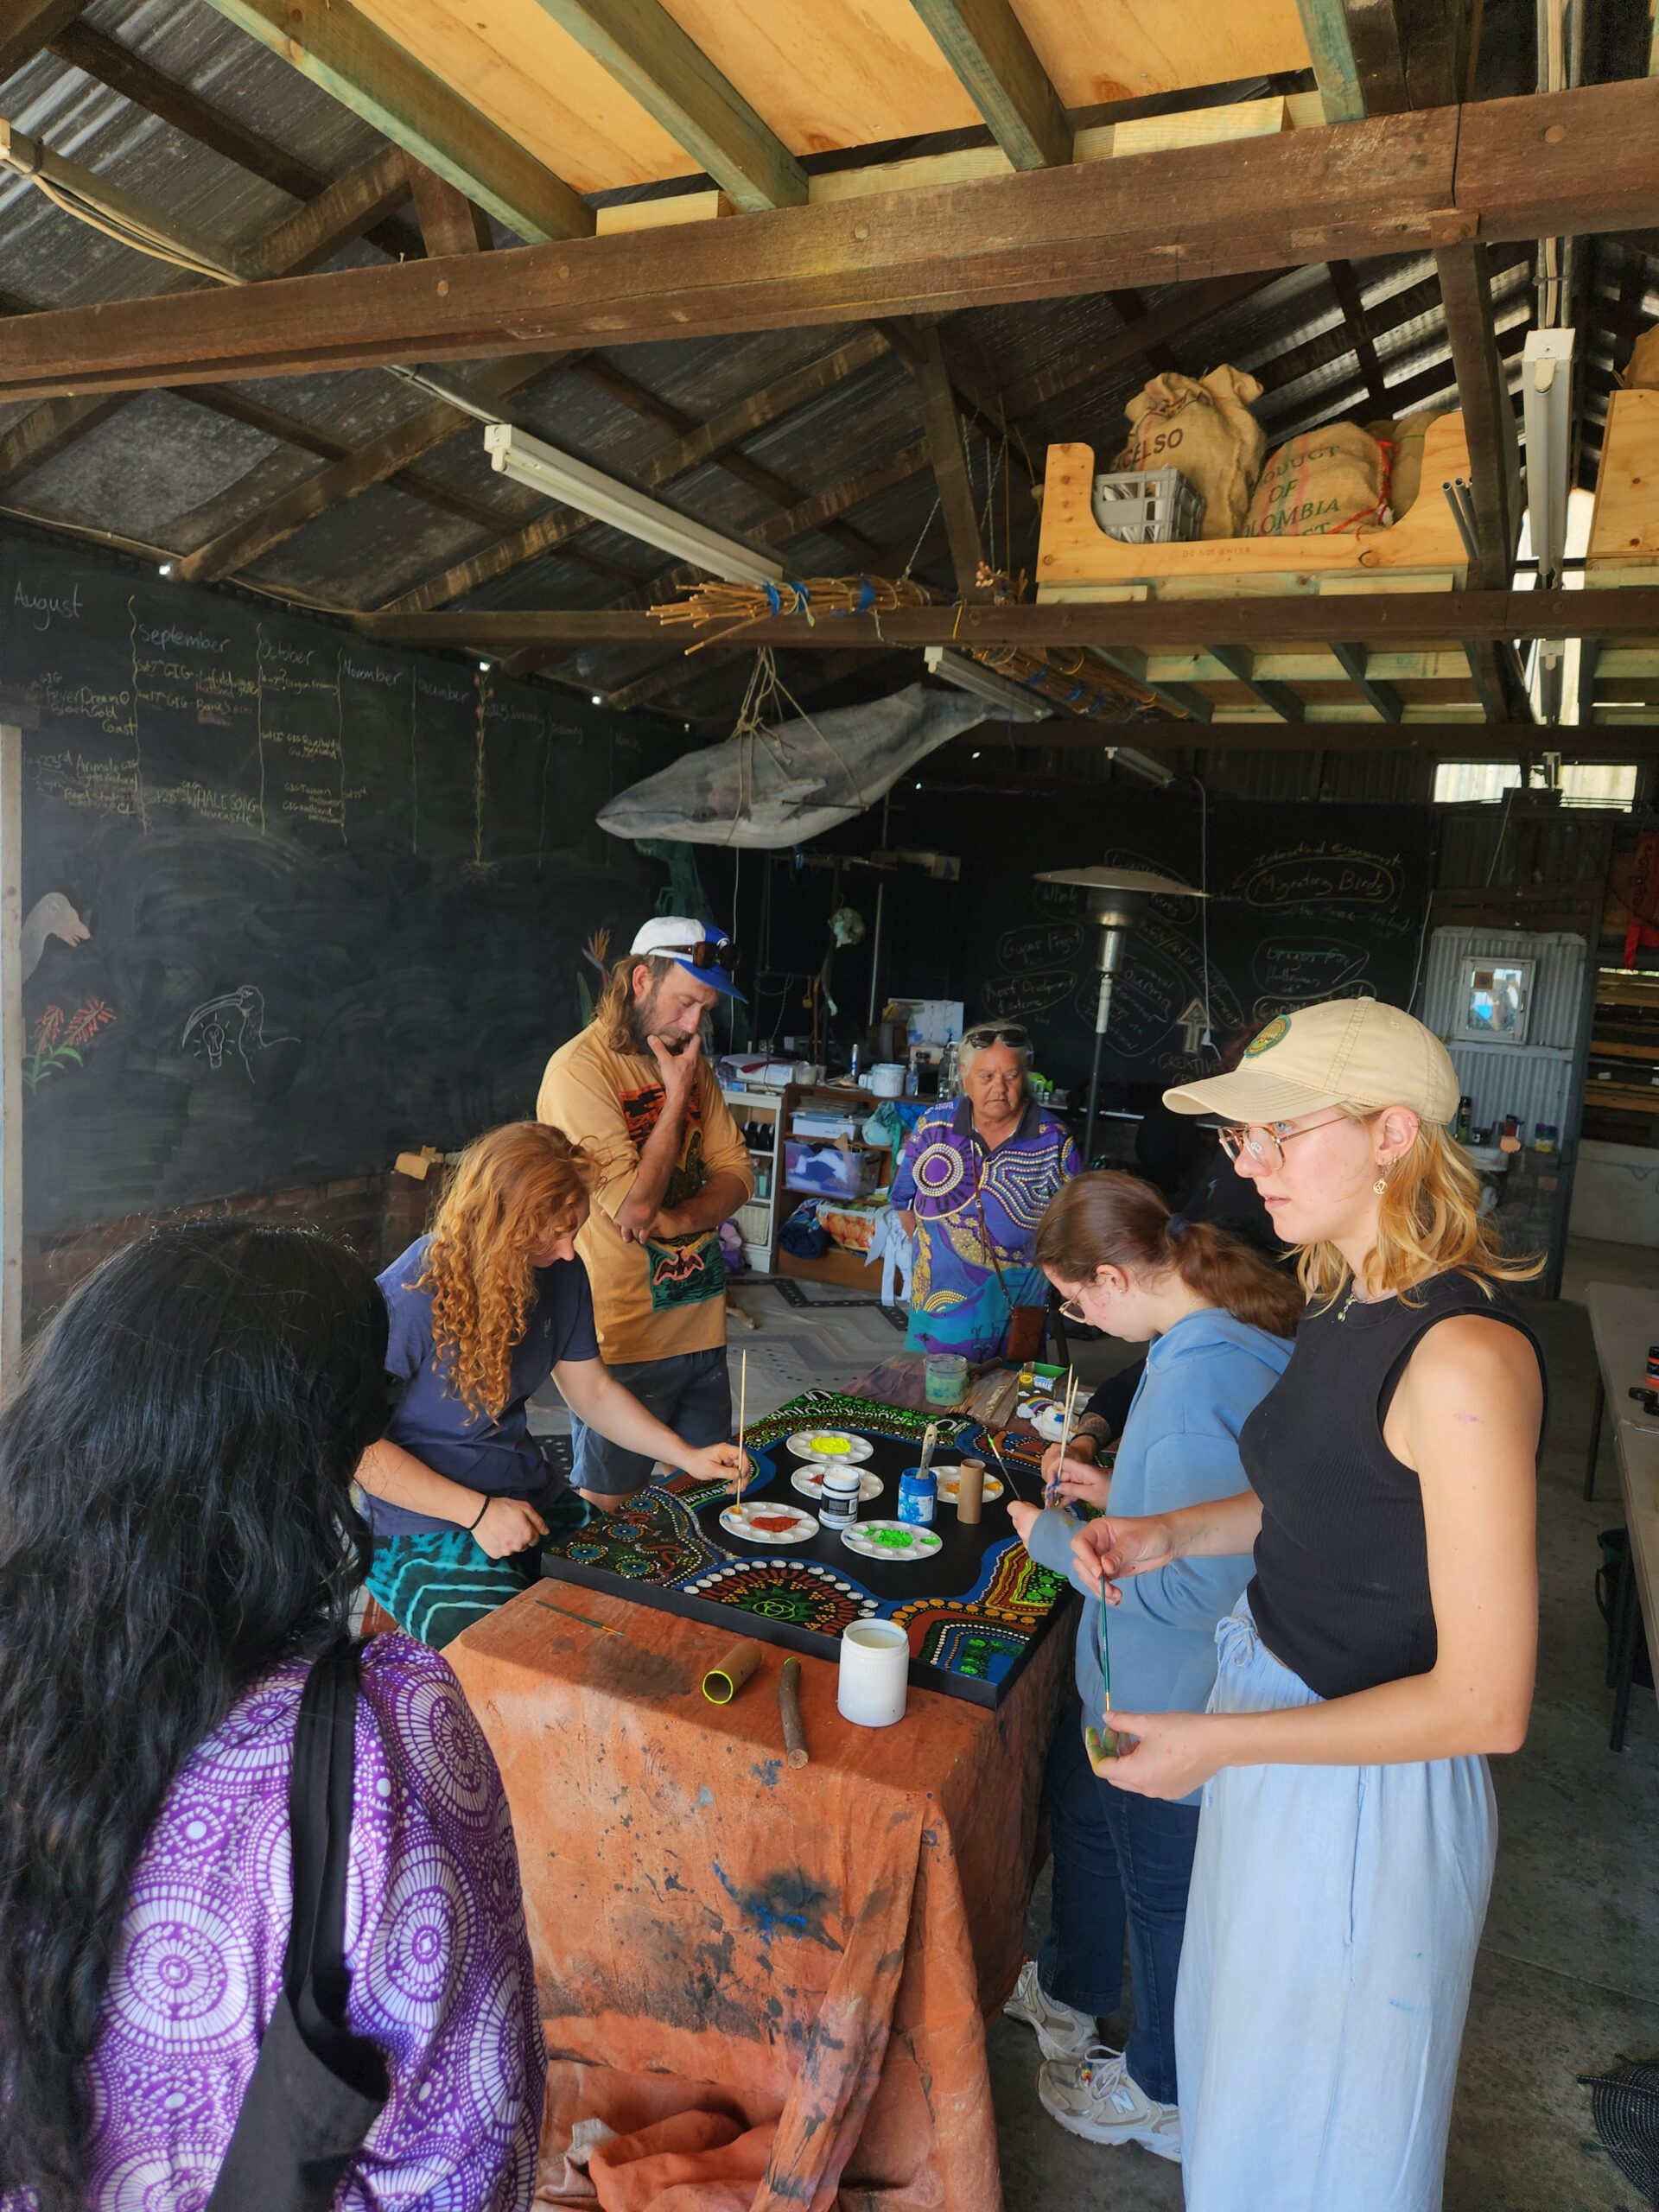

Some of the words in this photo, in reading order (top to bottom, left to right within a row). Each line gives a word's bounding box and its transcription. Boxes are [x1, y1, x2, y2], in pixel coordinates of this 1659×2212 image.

[1263, 446, 1340, 484] ODUCT
[1269, 480, 1298, 504] OF
[14, 582, 83, 631] August
[138, 624, 231, 653] September
[261, 640, 315, 666] October
[344, 659, 402, 686] November
[417, 678, 469, 702] December
[230, 796, 257, 816] SONG
[1109, 2091, 1135, 2113] N
